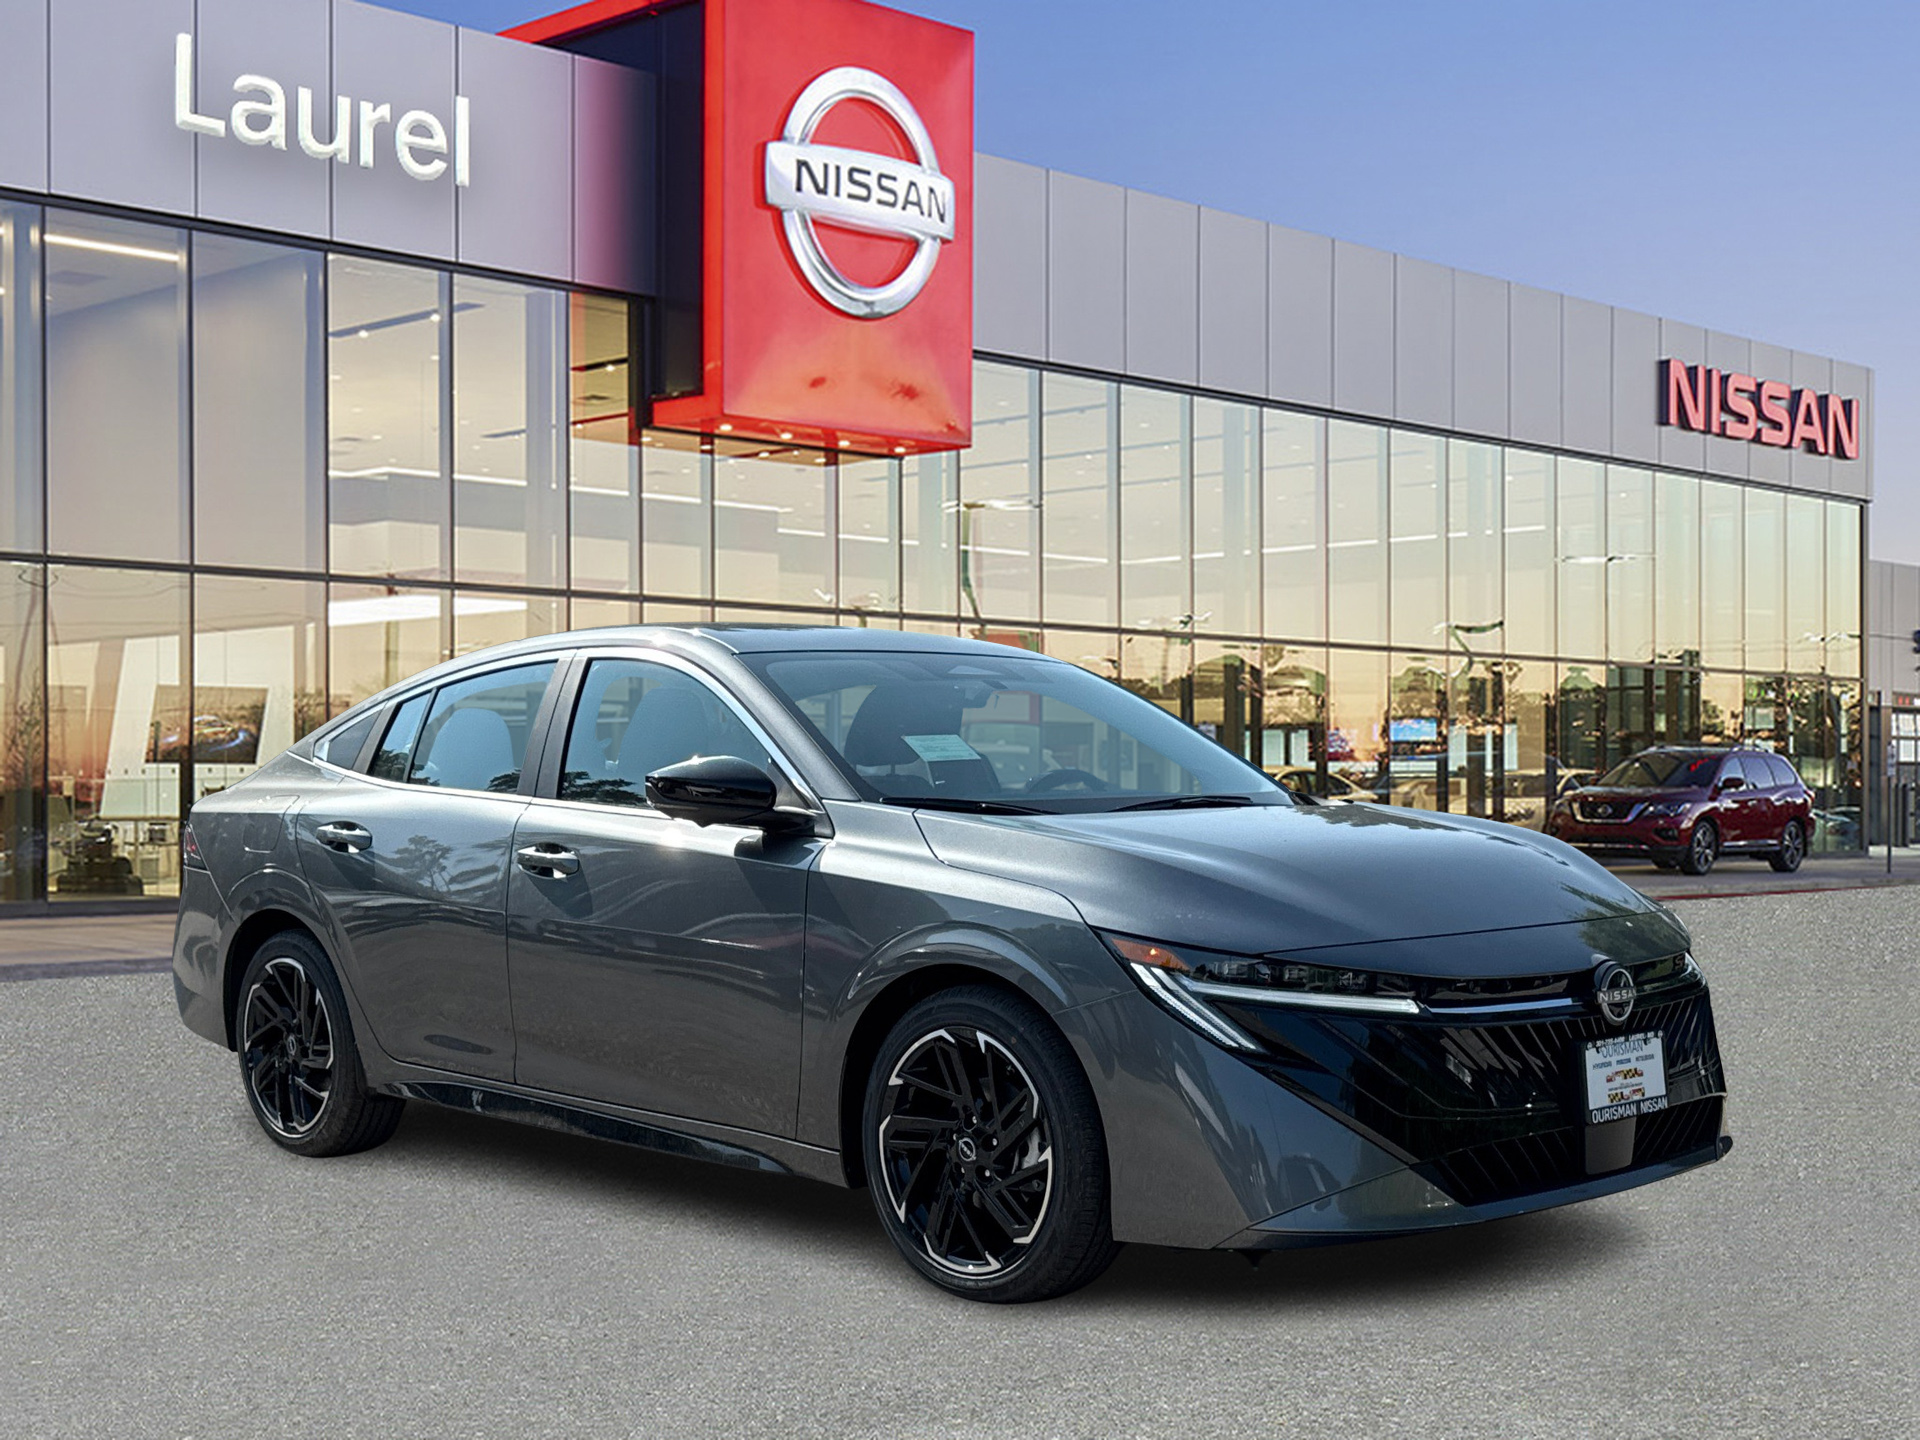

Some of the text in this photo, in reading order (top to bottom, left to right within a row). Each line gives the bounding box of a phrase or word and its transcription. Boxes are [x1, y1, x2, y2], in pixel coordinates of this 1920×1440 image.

[174, 32, 471, 188] Laurel
[794, 158, 947, 224] NISSAN
[1659, 358, 1860, 460] NISSAN
[1600, 988, 1636, 1002] NISSAN
[1601, 1040, 1643, 1059] OURISMAN
[1592, 1096, 1668, 1123] OURISMAN NISSAN
